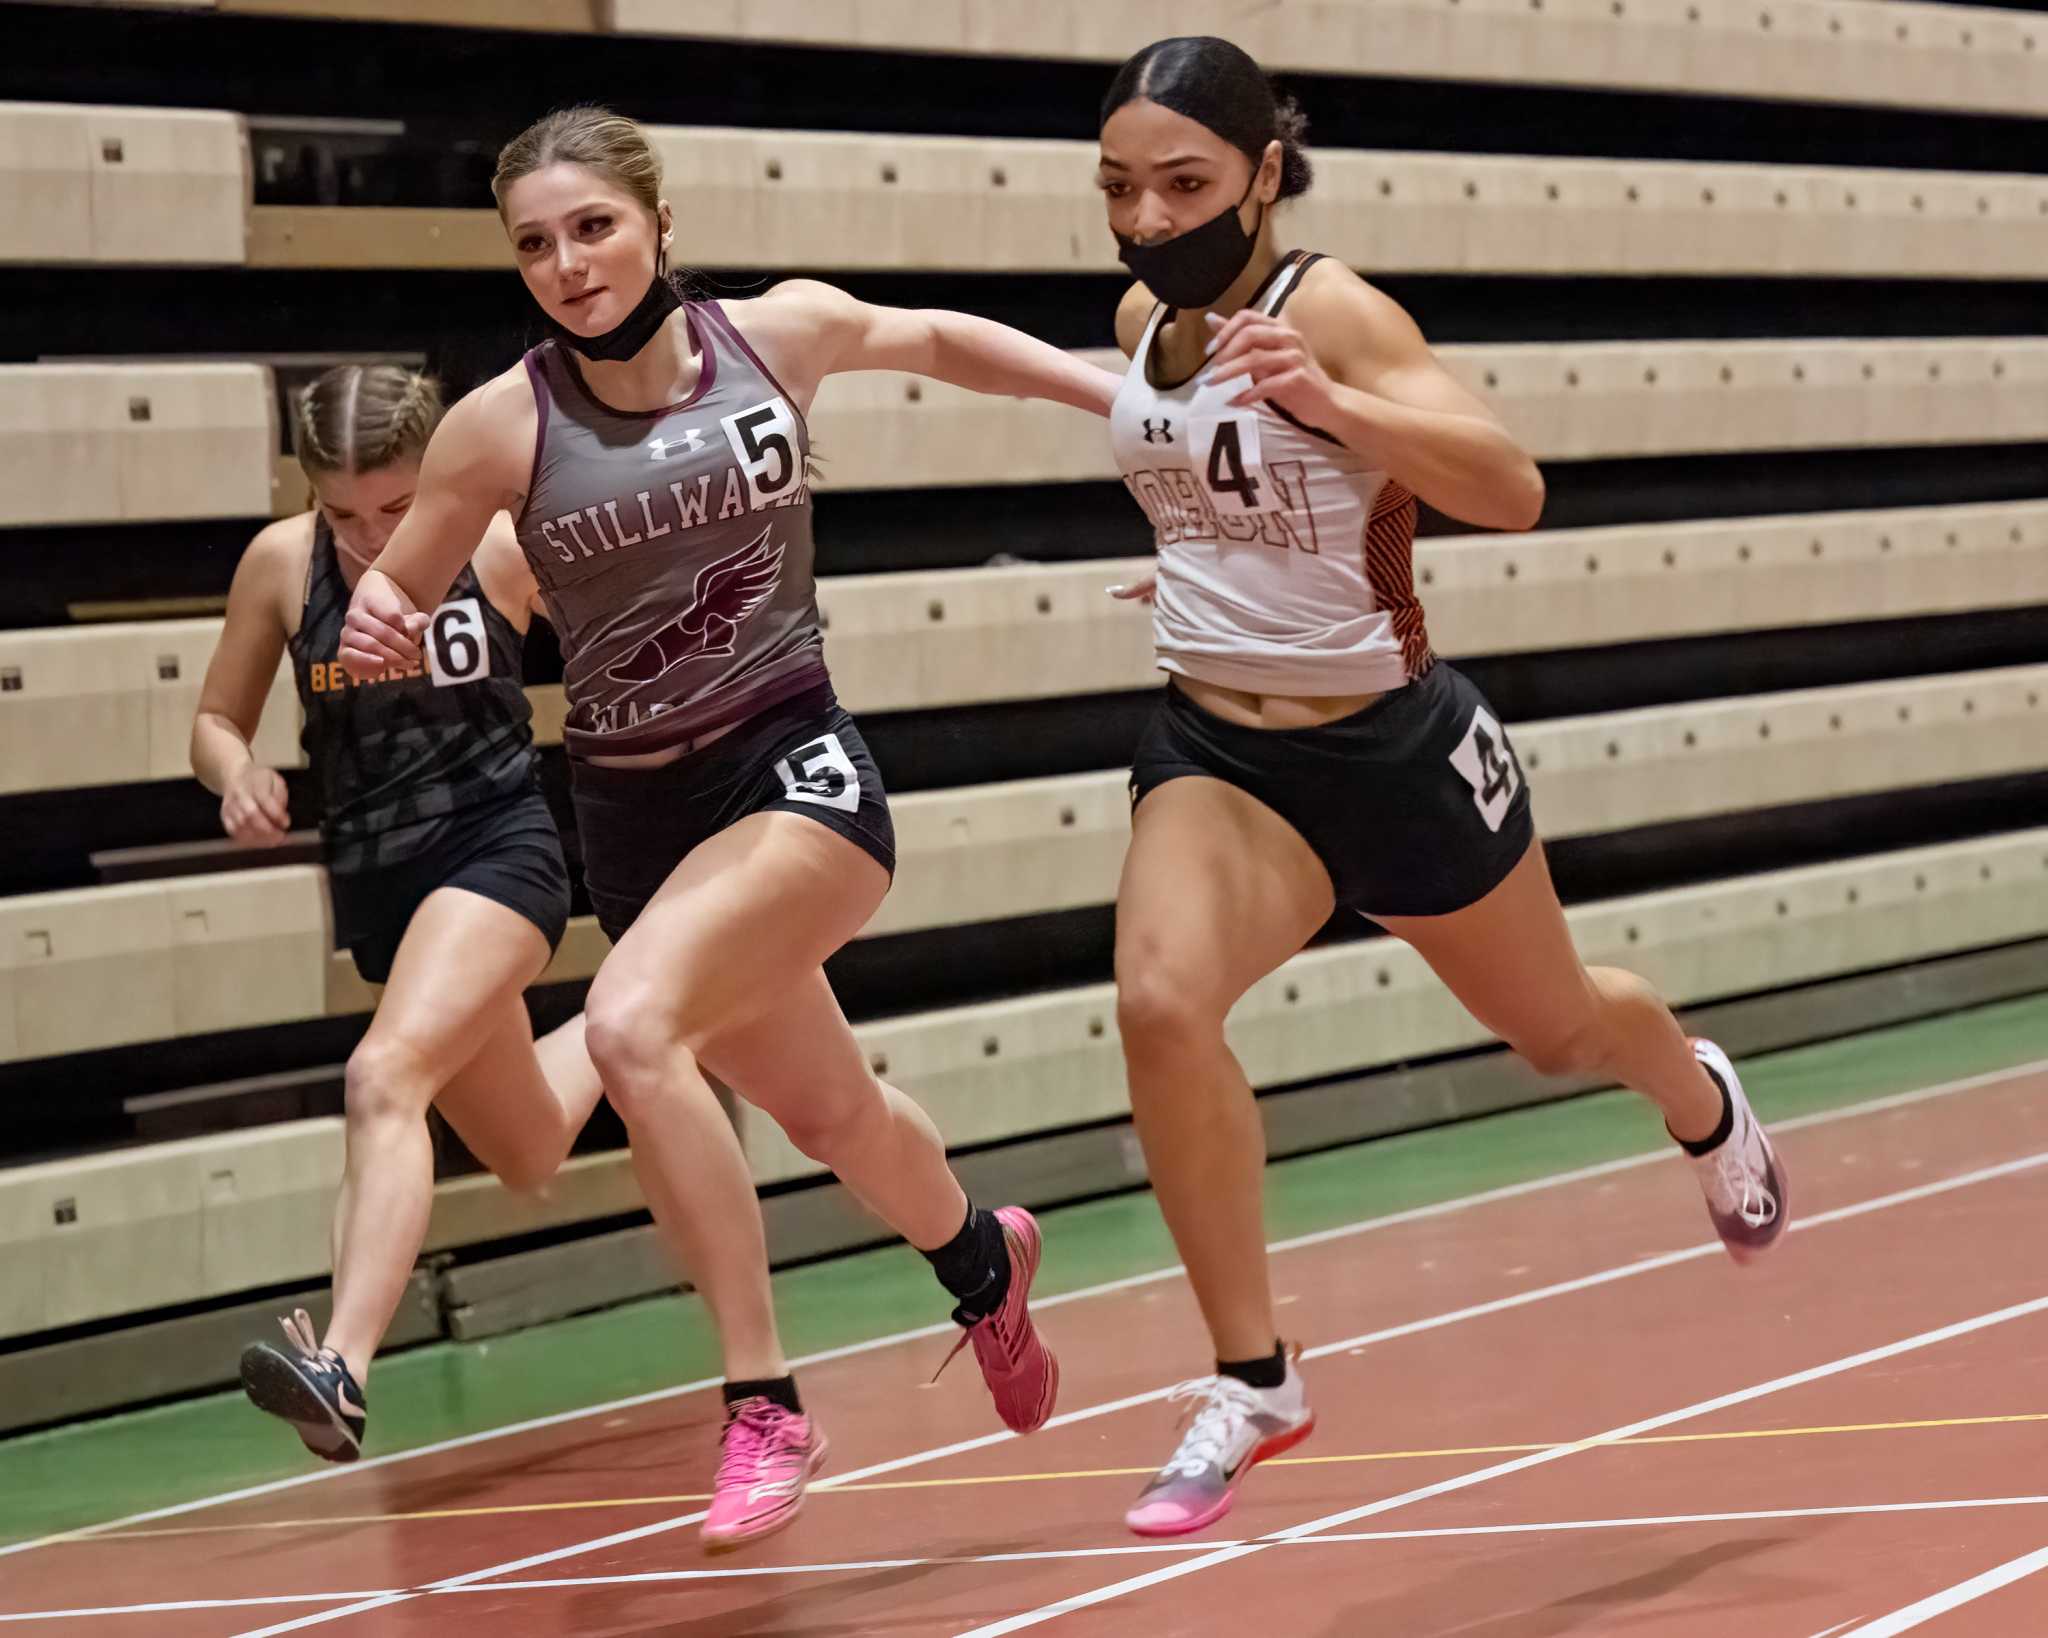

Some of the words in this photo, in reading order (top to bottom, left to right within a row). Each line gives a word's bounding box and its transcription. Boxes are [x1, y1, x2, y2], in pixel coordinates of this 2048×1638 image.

[734, 406, 793, 495] 5
[1206, 420, 1260, 508] 4
[432, 609, 481, 678] 6
[785, 741, 846, 798] 5
